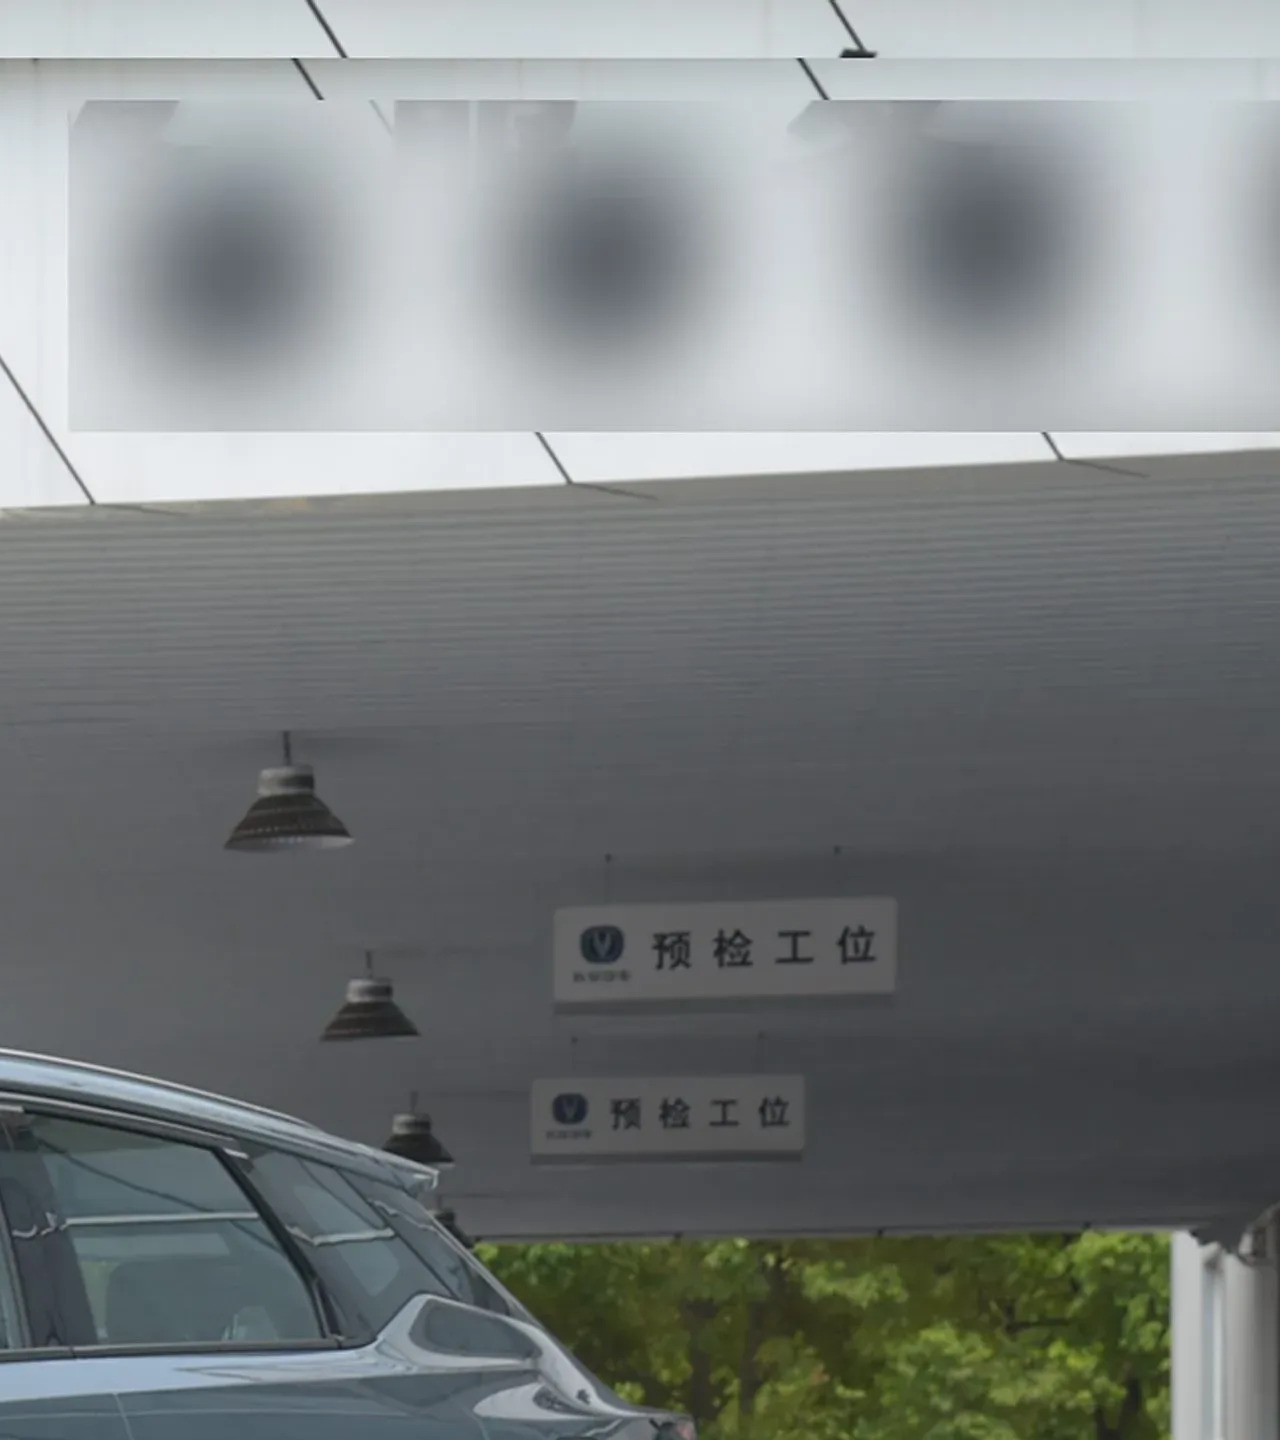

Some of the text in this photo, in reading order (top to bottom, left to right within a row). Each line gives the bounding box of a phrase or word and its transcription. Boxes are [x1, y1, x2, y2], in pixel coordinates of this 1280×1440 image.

[652, 924, 877, 970] 预检工位
[610, 1096, 791, 1131] 预检工位
